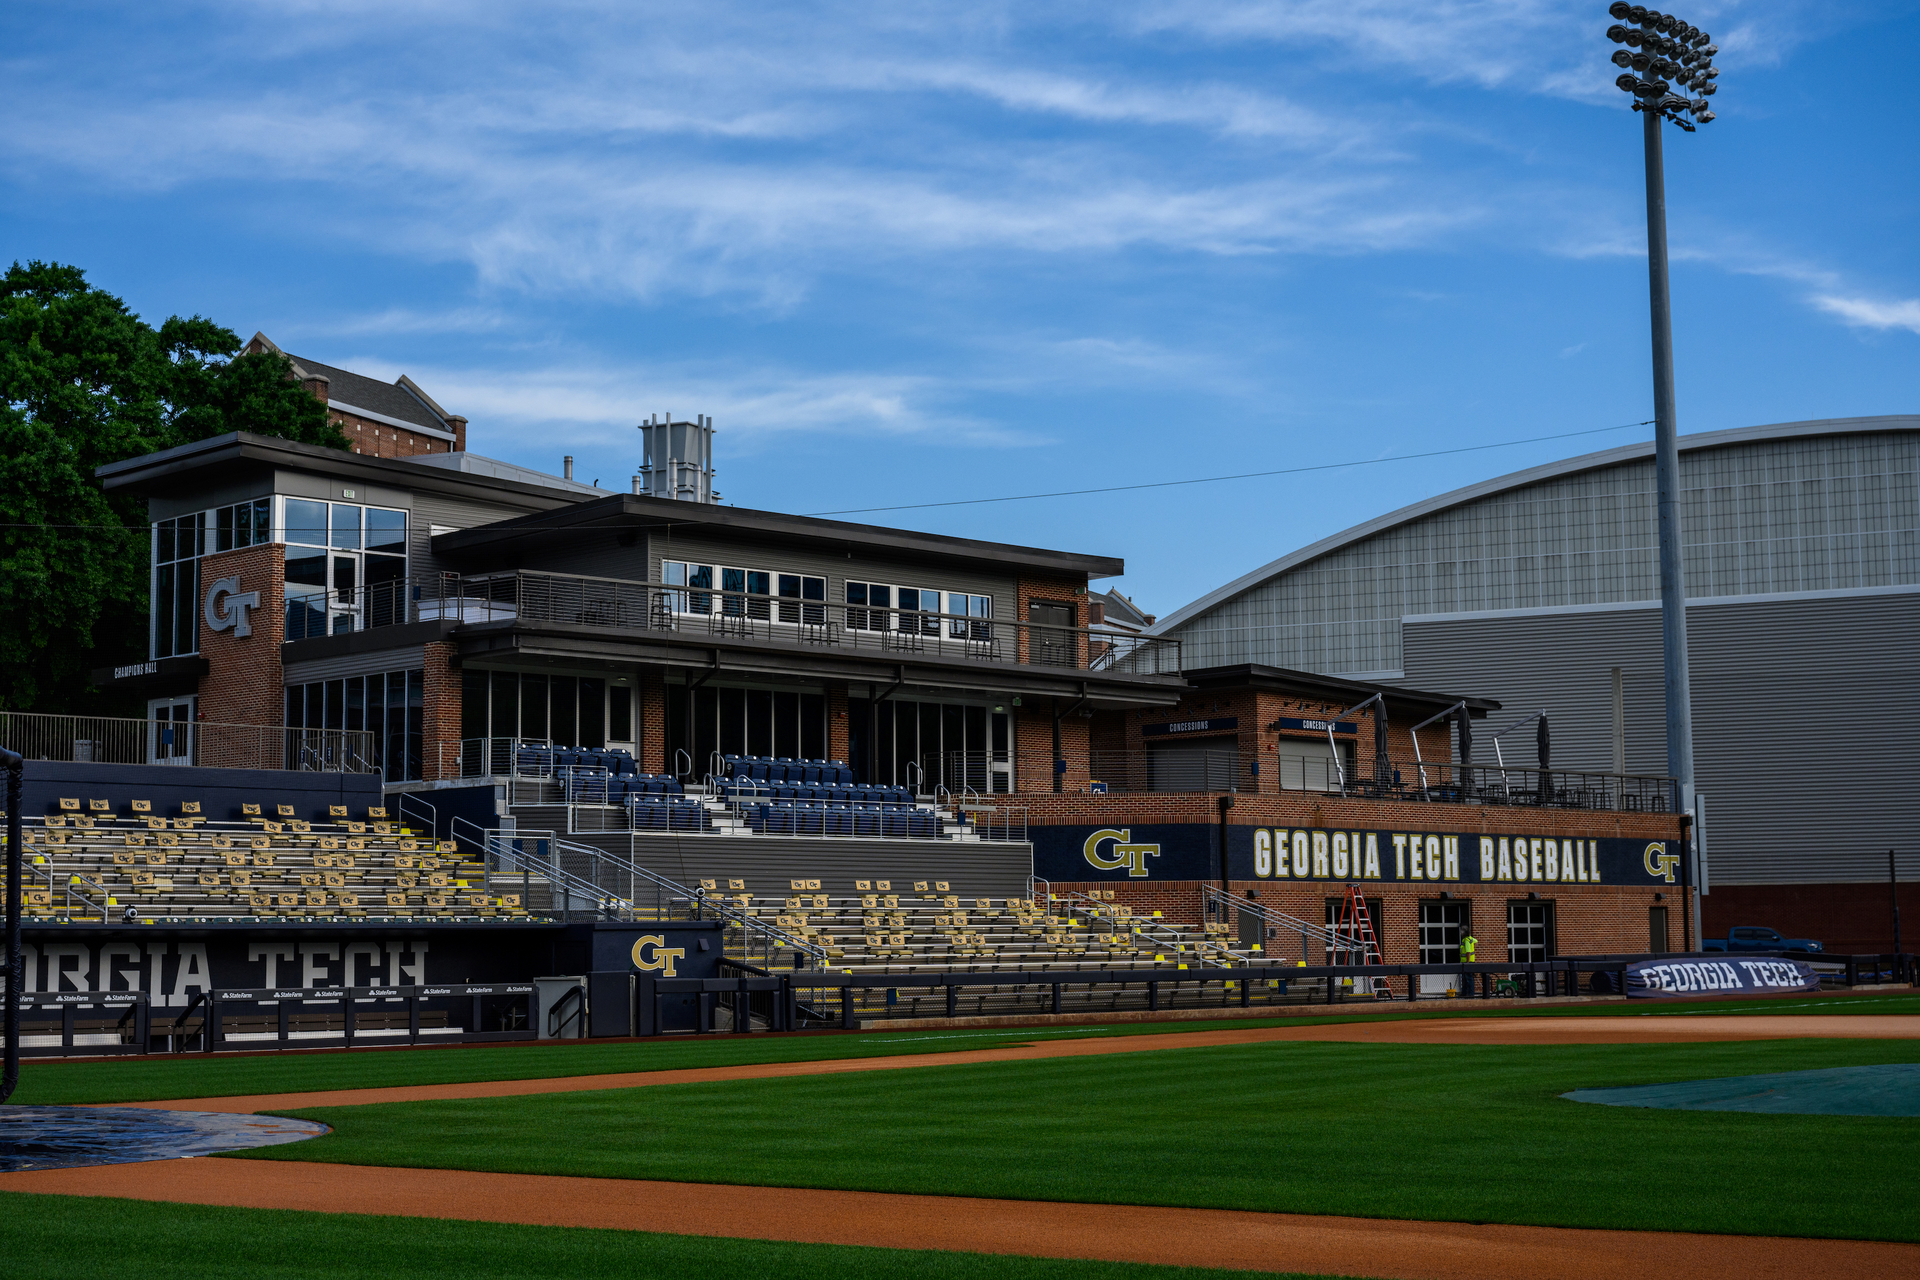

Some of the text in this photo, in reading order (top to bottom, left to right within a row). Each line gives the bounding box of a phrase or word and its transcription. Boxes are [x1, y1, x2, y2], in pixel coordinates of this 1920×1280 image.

[204, 575, 261, 638] GT
[114, 661, 157, 679] CHAMPIONS HALL
[1169, 720, 1209, 733] CONCESSIONS
[1303, 720, 1335, 730] CONCESSIS
[1083, 829, 1161, 877] GT
[1254, 828, 1601, 882] GEORGIA TECH BASEBALL
[1643, 842, 1680, 883] GT
[249, 941, 429, 1006] TECH
[631, 935, 685, 977] GT
[1639, 961, 1805, 992] GEORGIA TECH
